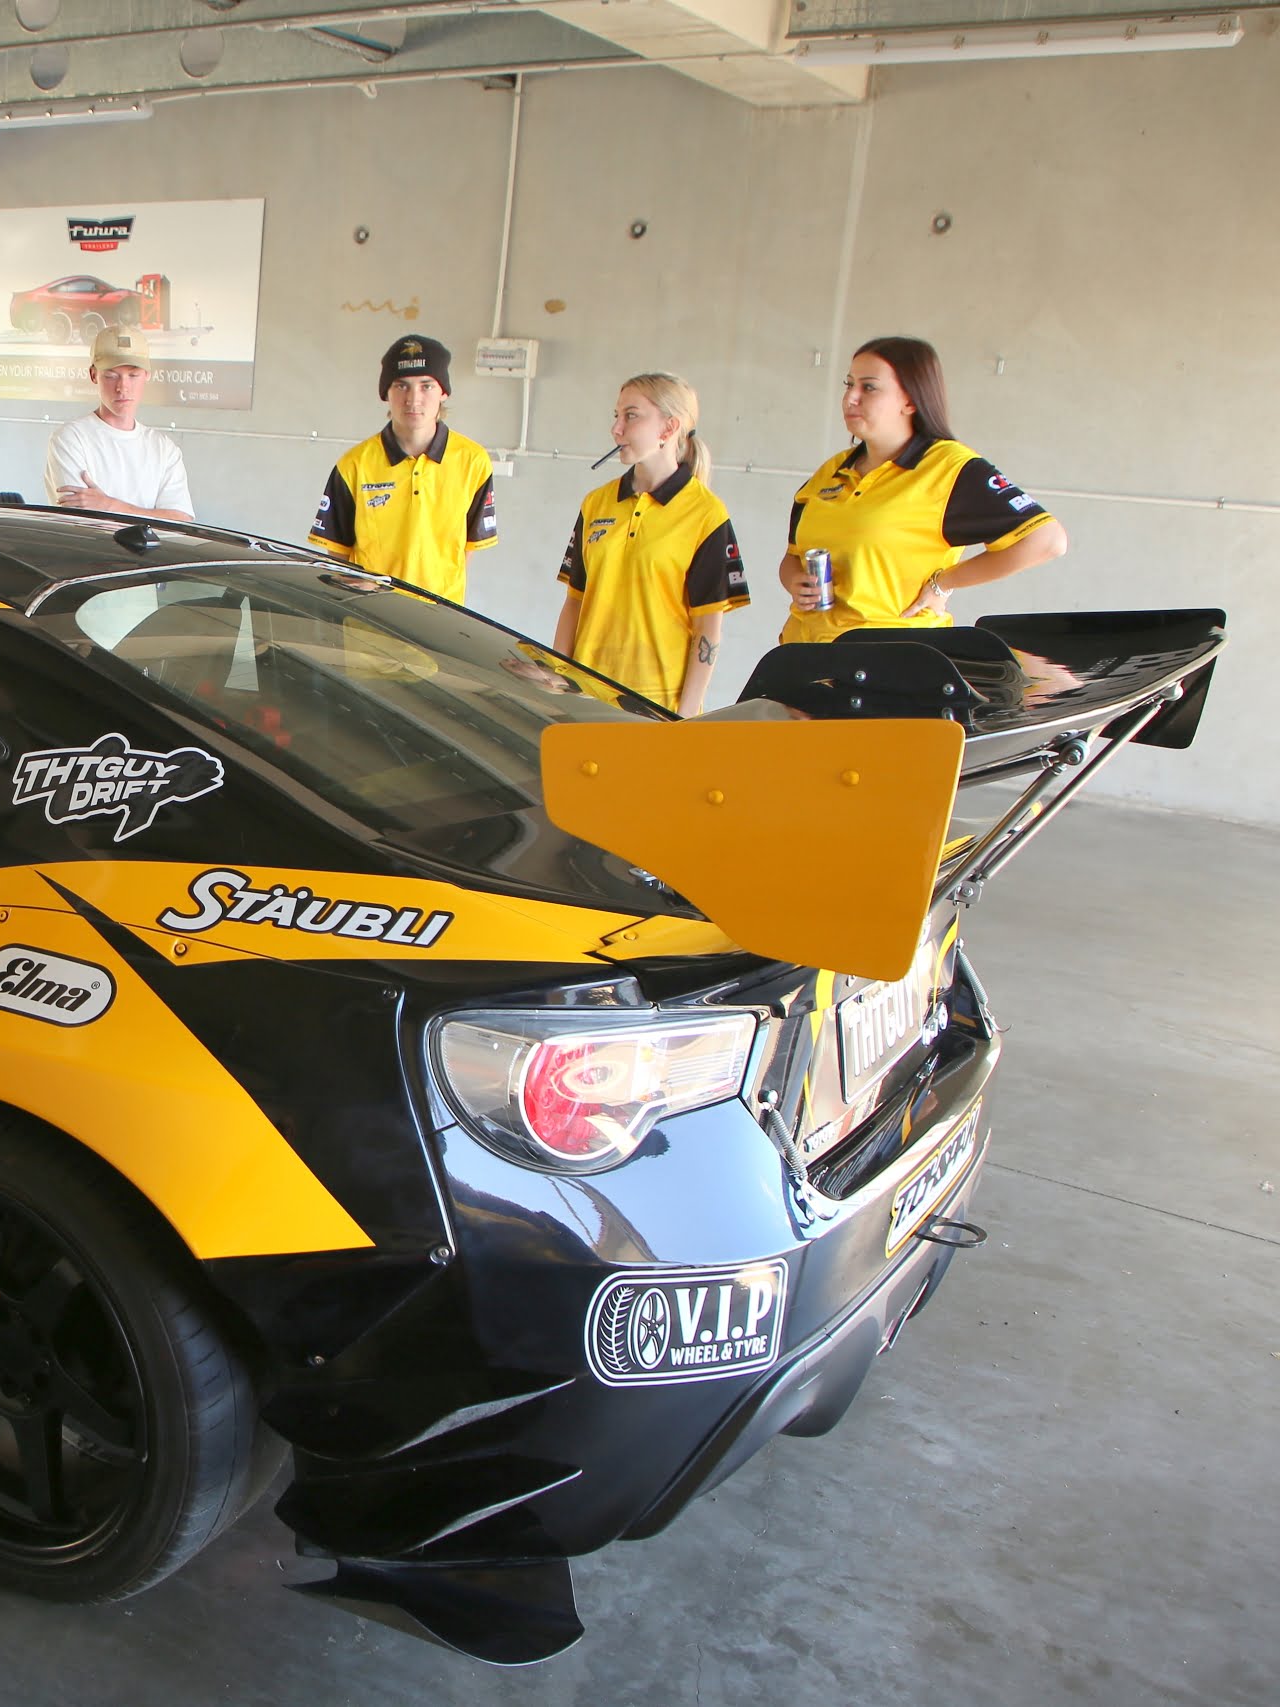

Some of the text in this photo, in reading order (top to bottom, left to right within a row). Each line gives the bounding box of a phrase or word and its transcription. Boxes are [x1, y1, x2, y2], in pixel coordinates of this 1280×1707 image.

[9, 365, 32, 378] YOUR
[34, 366, 67, 379] TRAILER
[68, 367, 76, 379] IS
[77, 368, 88, 379] AS
[152, 370, 165, 383] AS
[167, 370, 193, 384] YOUR
[194, 371, 214, 385] CAR
[24, 756, 181, 793] THTGUY
[68, 780, 170, 811] DRIFT
[160, 870, 450, 946] STÄUBLI
[675, 1281, 773, 1345] V.I.P
[670, 1344, 720, 1367] WHEEL
[734, 1335, 768, 1359] TYRE
